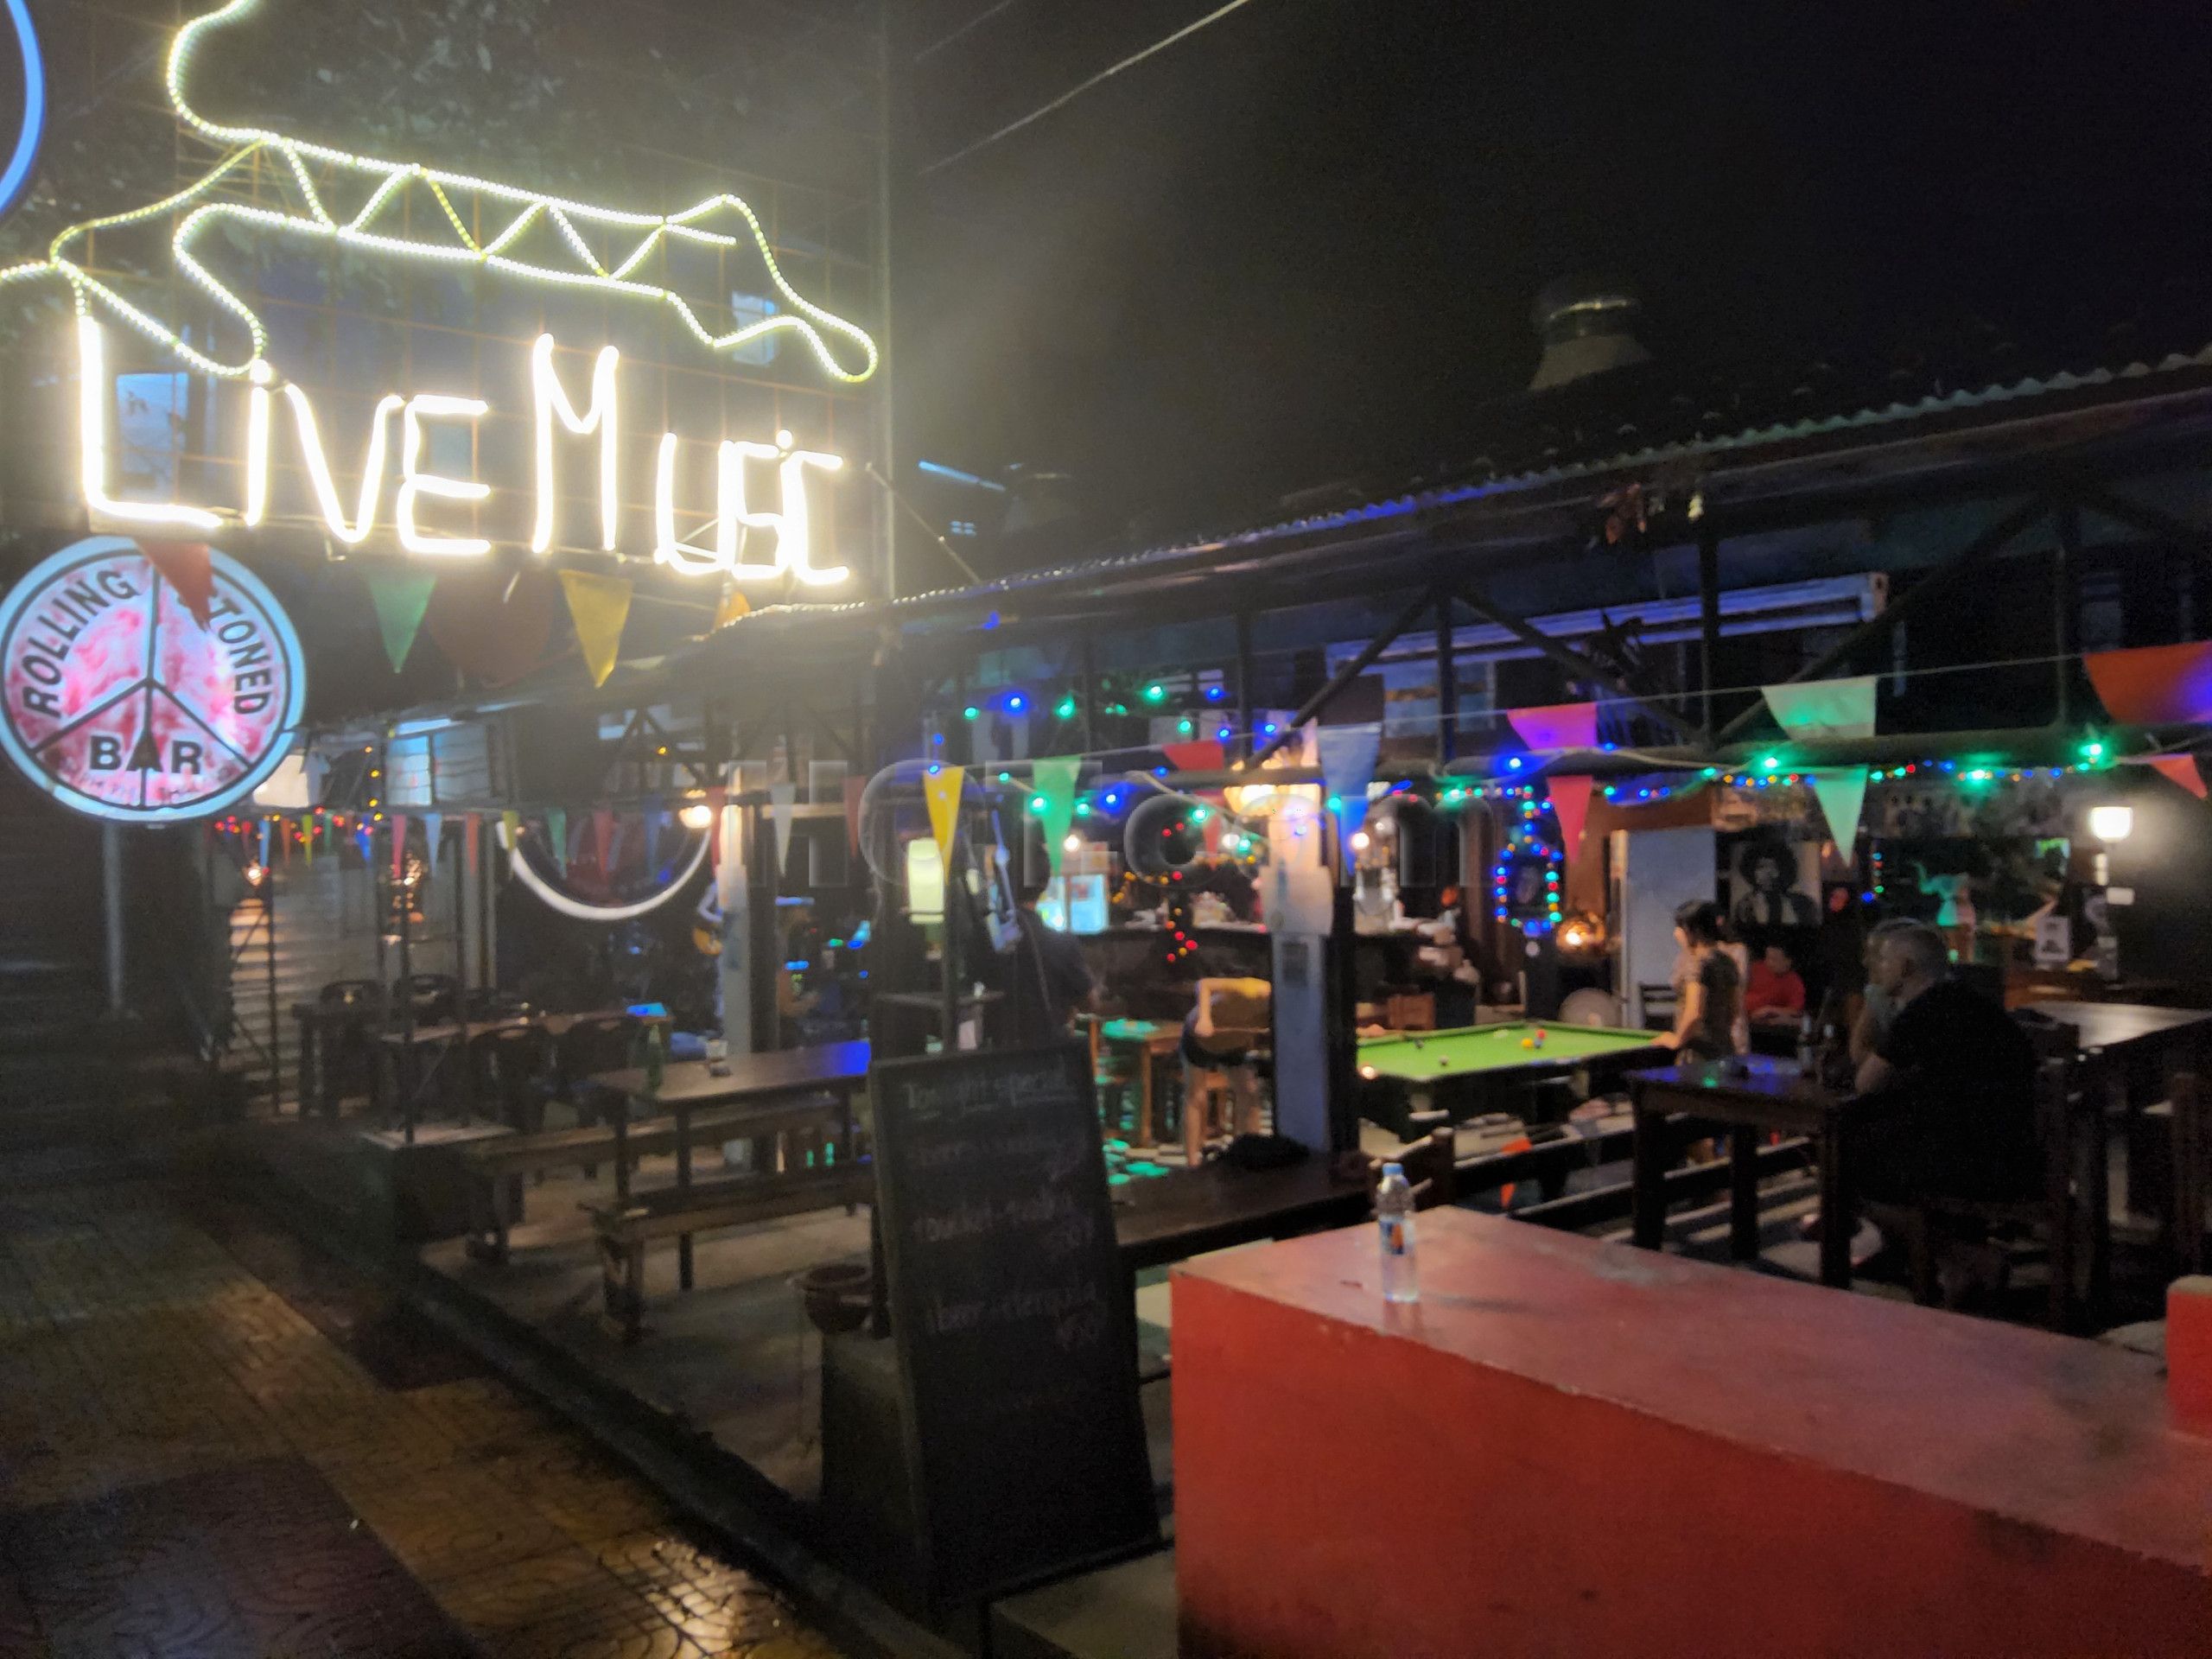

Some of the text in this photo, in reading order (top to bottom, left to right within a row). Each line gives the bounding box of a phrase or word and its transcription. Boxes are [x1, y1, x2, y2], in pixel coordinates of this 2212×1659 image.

[22, 569, 273, 719] ROLLING TONED
[89, 734, 202, 775] BAR
